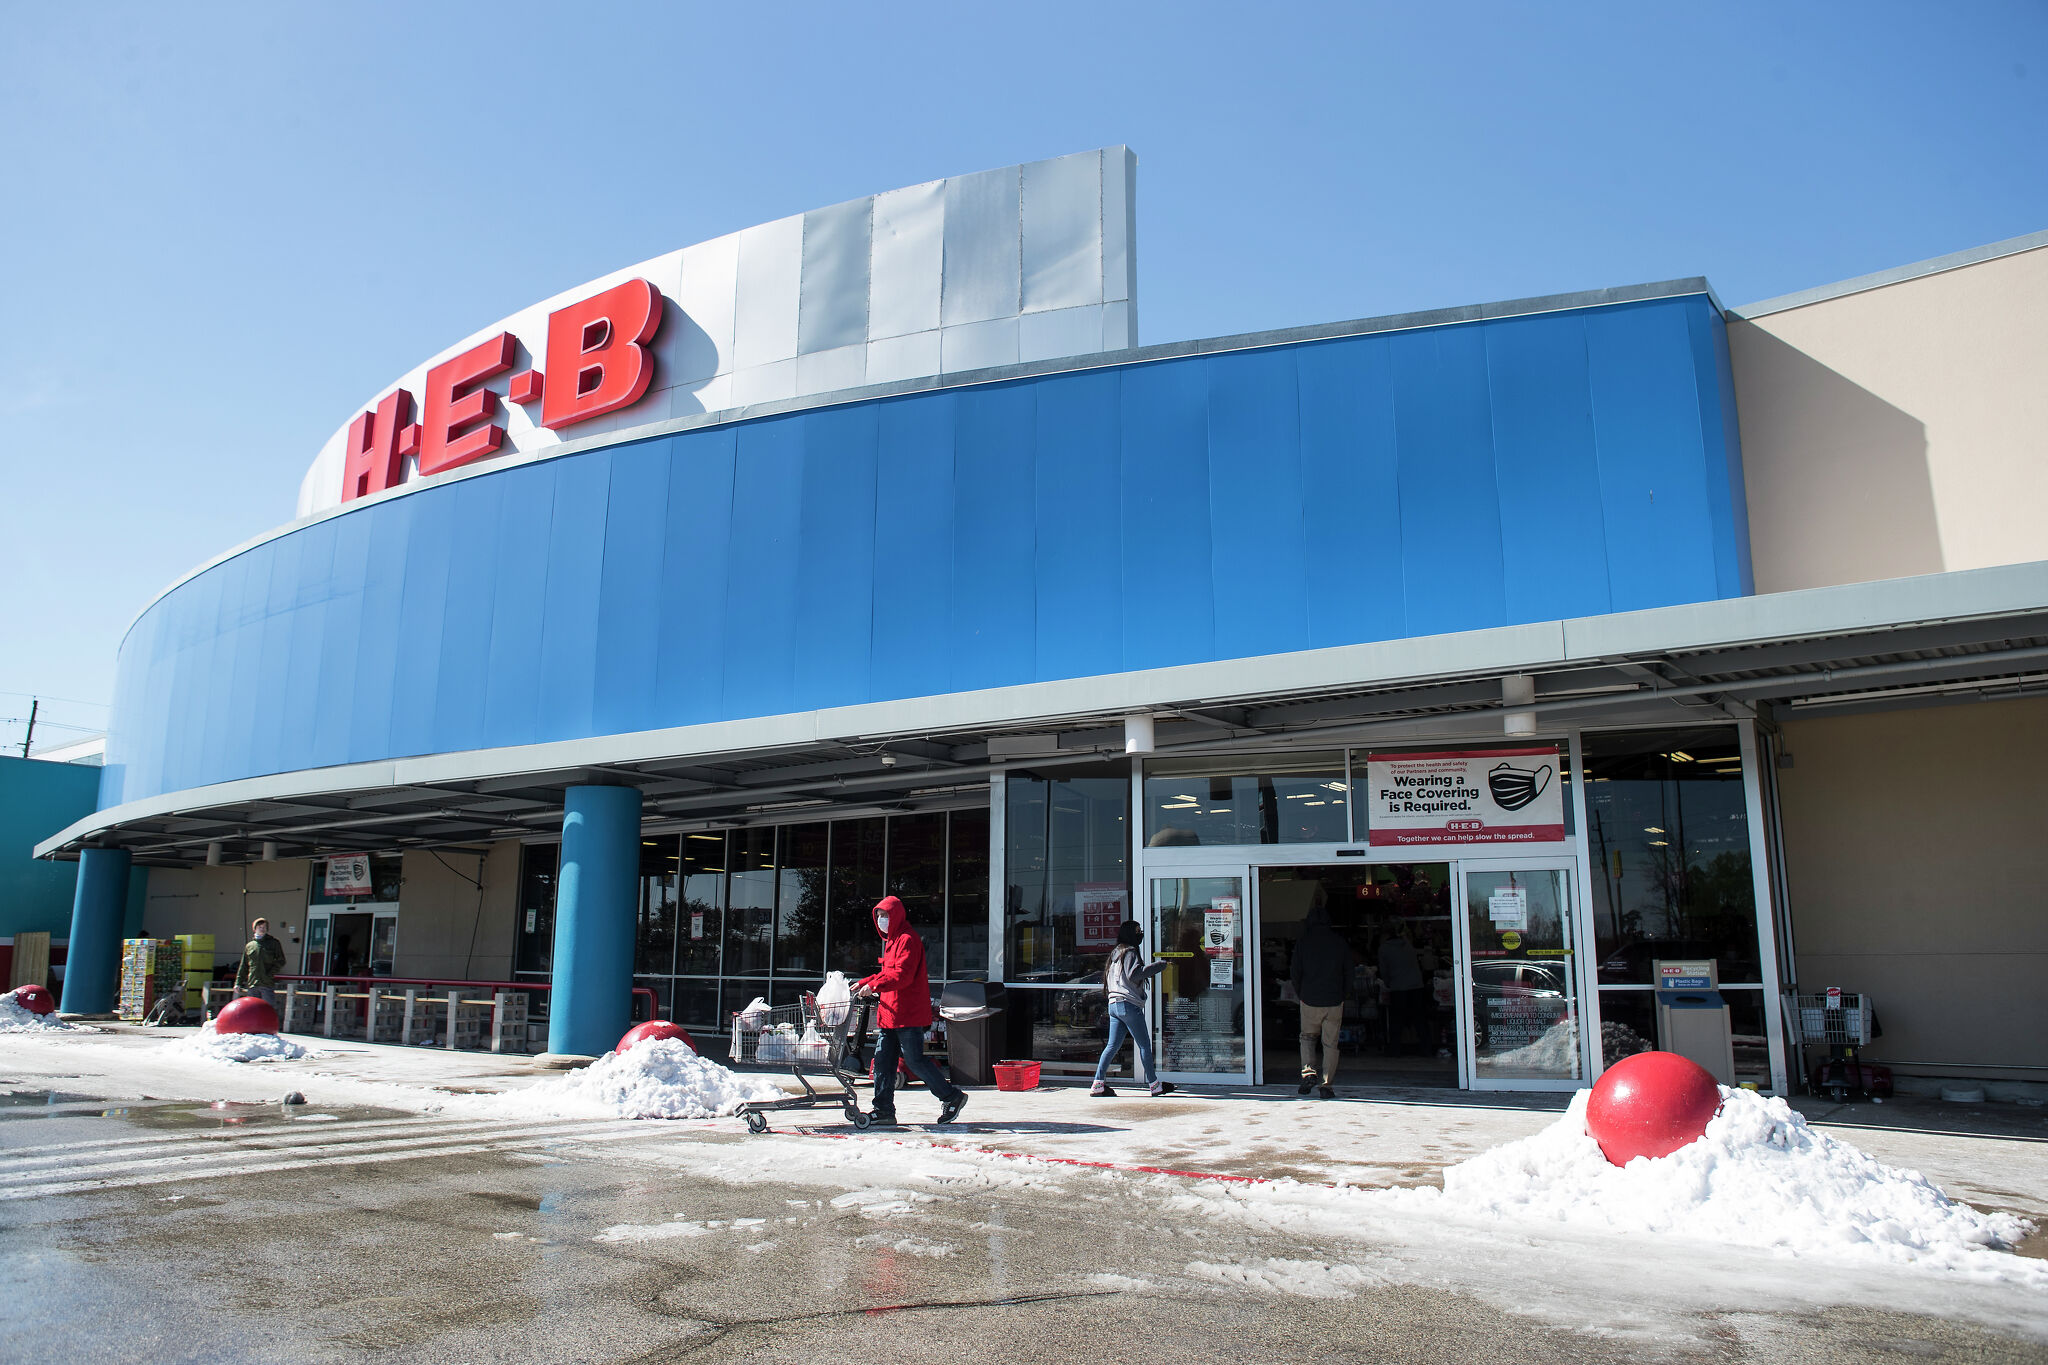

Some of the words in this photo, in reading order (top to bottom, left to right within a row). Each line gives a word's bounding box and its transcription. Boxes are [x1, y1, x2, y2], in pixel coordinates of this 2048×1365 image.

[1394, 774, 1452, 787] Wearing
[1456, 776, 1464, 784] a
[1380, 790, 1412, 800] Face
[1416, 786, 1479, 799] Covering
[1390, 802, 1400, 812] is
[1404, 800, 1471, 813] Required.
[1398, 834, 1429, 842] Together
[1362, 888, 1368, 896] 6
